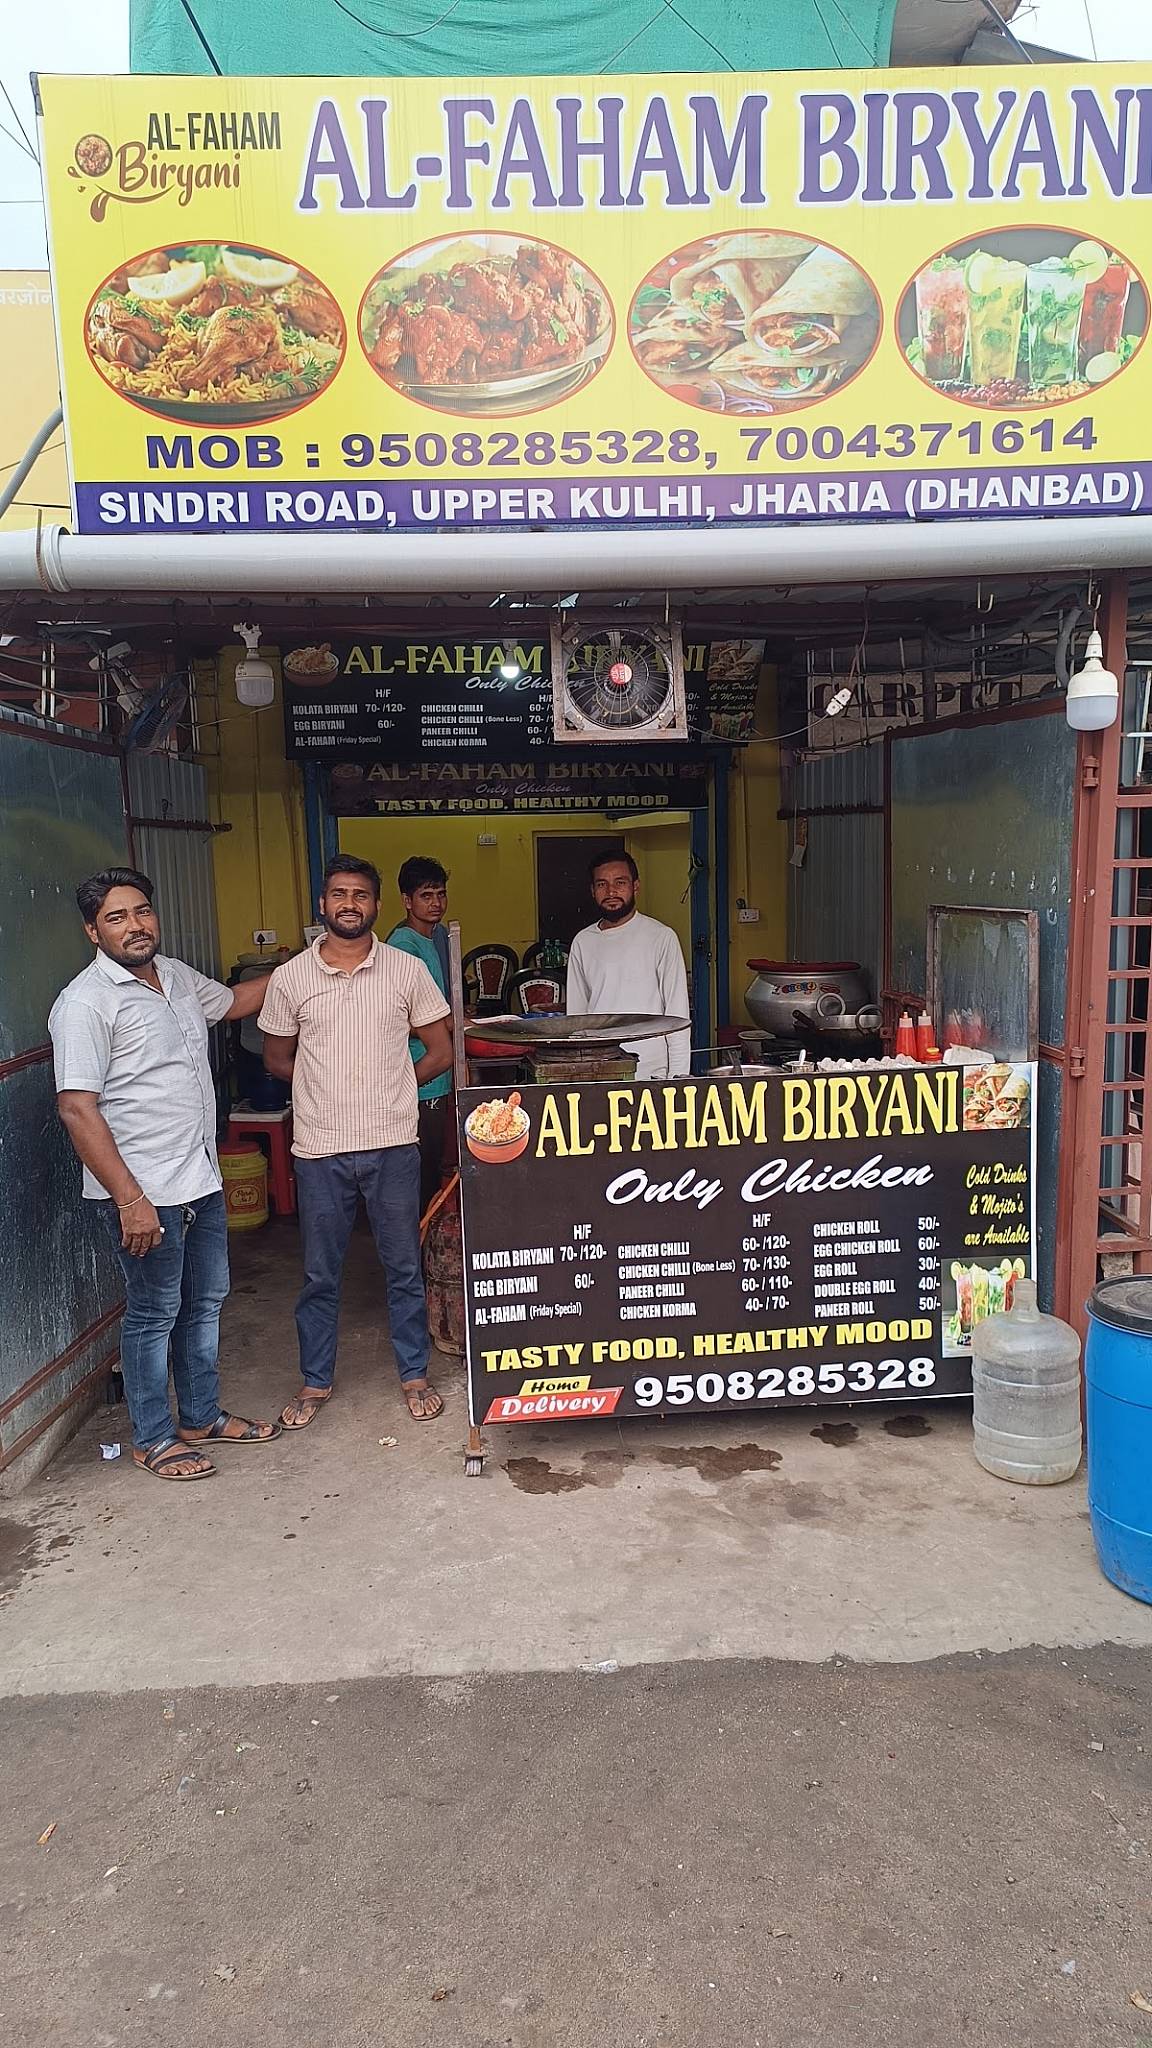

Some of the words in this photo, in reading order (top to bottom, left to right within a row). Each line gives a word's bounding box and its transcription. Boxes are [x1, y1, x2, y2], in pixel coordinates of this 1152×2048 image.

[147, 112, 282, 151] AL-FAHAM
[299, 95, 768, 209] AL-FAHAM
[799, 89, 1152, 201] BIRYANI
[116, 142, 241, 205] Biryani
[146, 434, 285, 469] MOB
[305, 440, 321, 469] :
[341, 429, 718, 469] 9508285328,
[739, 417, 1098, 462] 7004371614
[99, 490, 250, 525] SINDRI
[267, 490, 398, 528] ROAD,
[412, 487, 556, 522] UPPER
[570, 485, 717, 523] KULHI,
[729, 479, 891, 516] JHARIA
[905, 471, 1145, 518] (DHANBAD)
[343, 645, 545, 674] AL-FAHAM
[375, 689, 392, 699] H/F
[465, 676, 509, 692] Only
[325, 703, 358, 714] BIRYANI
[365, 703, 380, 713] 70-
[382, 703, 406, 713] /120-
[421, 704, 457, 713] CHICKEN
[458, 704, 484, 713] CHILLI
[529, 704, 544, 712] 60-
[421, 716, 457, 725] CHICKEN
[458, 715, 484, 724] CHILLI
[529, 715, 544, 723] 70-
[294, 720, 311, 731] EGG
[312, 719, 345, 730] BIRYANI
[377, 719, 395, 729] 60/-
[453, 726, 478, 735] CHILLI
[527, 726, 543, 734] 60-
[295, 735, 336, 747] AL-FAHAM
[421, 738, 458, 747] CHICKEN
[529, 737, 544, 746] 40-
[367, 762, 536, 781] AL-FAHAM
[475, 783, 509, 796] Only
[514, 782, 571, 795] Chicken
[375, 799, 443, 812] TASTY
[514, 796, 602, 809] HEALTHY
[607, 794, 669, 808] MOOD
[535, 1081, 768, 1158] AL-FAHAM
[782, 1071, 959, 1143] BIRYANI
[606, 1169, 724, 1210] Only
[740, 1155, 934, 1204] Chicken
[966, 1163, 991, 1188] Cold
[994, 1162, 1028, 1185] Drinks
[970, 1193, 979, 1214] &
[981, 1192, 1024, 1217] Mojito's
[573, 1223, 593, 1240] H/F
[752, 1213, 771, 1228] H/F
[813, 1222, 854, 1238] CHICKEN
[855, 1220, 880, 1235] ROLL
[918, 1216, 940, 1231] 50/-
[618, 1243, 659, 1260] CHICKEN
[660, 1241, 690, 1257] CHILLI
[742, 1236, 760, 1251] 60-
[762, 1234, 790, 1250] /120-
[813, 1243, 833, 1259] EGG
[834, 1240, 876, 1257] CHICKEN
[877, 1238, 901, 1254] ROLL
[918, 1236, 940, 1251] 60/-
[965, 1232, 982, 1246] are
[983, 1226, 1029, 1246] Available
[472, 1250, 511, 1271] KOLATA
[512, 1247, 554, 1268] BIRYANI
[560, 1245, 577, 1262] 70-
[579, 1243, 607, 1261] /120-
[618, 1263, 660, 1280] CHICKEN
[661, 1261, 691, 1277] CHILLI
[692, 1260, 714, 1275] (Bone
[715, 1259, 736, 1273] Less)
[742, 1257, 760, 1272] 70-
[762, 1256, 790, 1270] /130-
[813, 1264, 832, 1279] EGG
[833, 1261, 857, 1276] ROLL
[918, 1257, 940, 1271] 30/-
[473, 1279, 495, 1298] EGG
[496, 1275, 539, 1297] BIRYANI
[574, 1272, 595, 1290] 60/-
[619, 1284, 654, 1300] PANEER
[655, 1282, 685, 1298] CHILLI
[741, 1277, 760, 1291] 60-
[769, 1275, 793, 1290] 110-
[814, 1283, 850, 1298] DOUBLE
[851, 1281, 870, 1296] EGG
[871, 1279, 896, 1294] ROLL
[918, 1276, 941, 1291] 40/-
[474, 1304, 527, 1326] AL-FAHAM
[529, 1303, 554, 1319] (Friday
[554, 1301, 582, 1317] Special)
[620, 1304, 661, 1321] CHICKEN
[662, 1302, 696, 1318] KORMA
[745, 1297, 764, 1311] 40-
[771, 1296, 790, 1310] 70-
[814, 1303, 850, 1318] PANEER
[851, 1301, 875, 1316] ROLL
[918, 1296, 941, 1311] 50/-
[481, 1342, 584, 1372] TASTY
[592, 1336, 686, 1363] FOOD,
[693, 1325, 829, 1356] HEALTHY
[836, 1319, 934, 1345] MOOD
[530, 1378, 581, 1394] Home
[634, 1357, 936, 1407] 9508285328
[501, 1394, 607, 1417] Delivery
